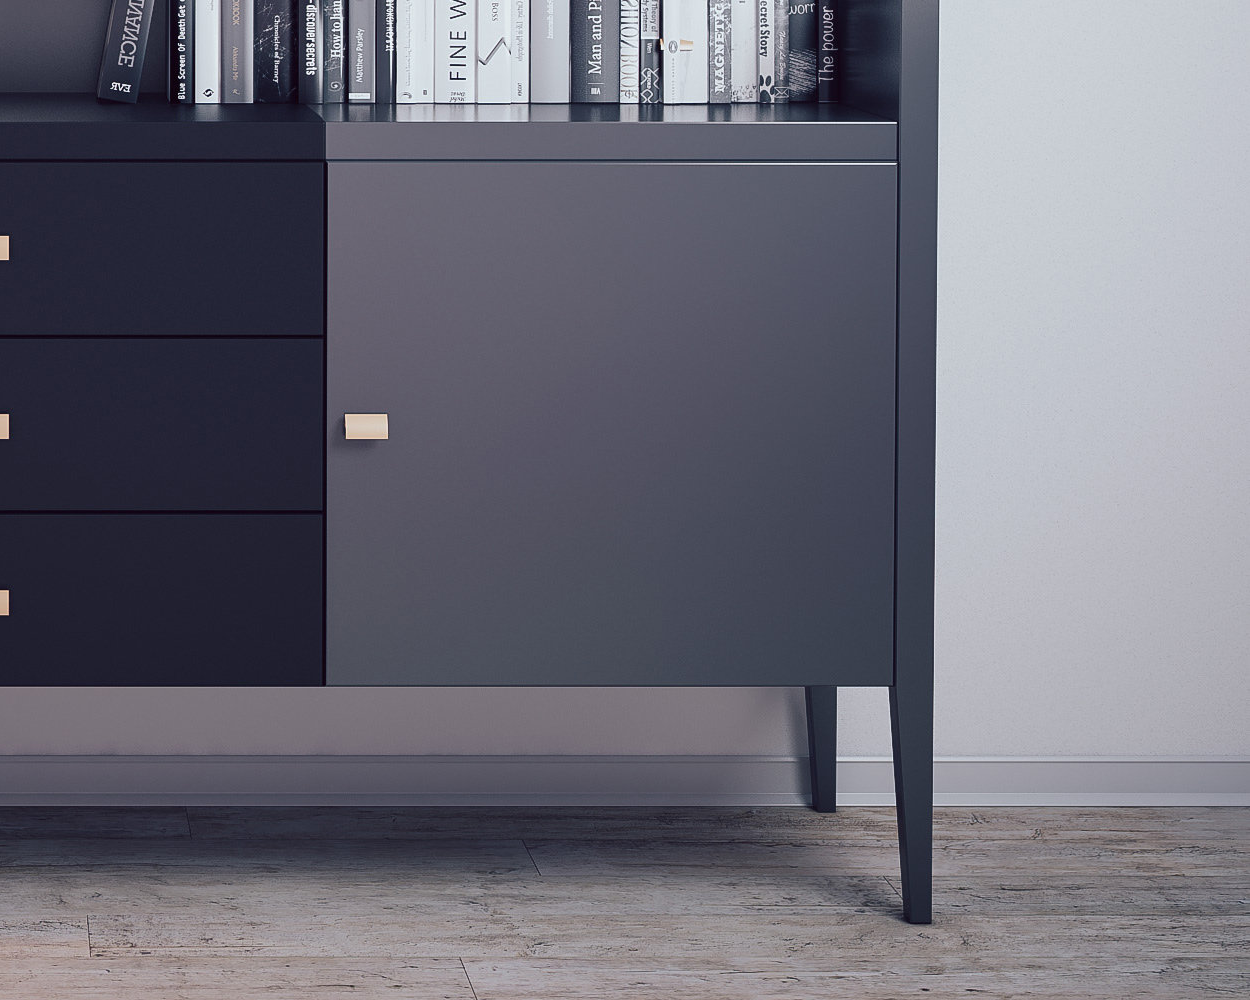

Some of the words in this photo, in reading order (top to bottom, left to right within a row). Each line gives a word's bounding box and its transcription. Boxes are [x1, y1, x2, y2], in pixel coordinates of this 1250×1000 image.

[178, 4, 187, 18] Get
[306, 5, 319, 42] discover
[641, 7, 649, 33] Systems
[650, 3, 659, 24] Theory
[178, 19, 187, 40] Death
[272, 15, 281, 50] Chronicles
[330, 22, 342, 33] to
[355, 28, 366, 51] Parsley
[587, 13, 603, 41] and
[822, 5, 838, 51] power
[178, 42, 187, 52] Of
[330, 34, 342, 58] How
[449, 31, 467, 81] FINE
[714, 2, 725, 94] MAGNETIC
[759, 29, 770, 58] Story
[178, 55, 187, 80] Screen
[272, 60, 281, 84] Barney
[306, 43, 319, 76] secrets
[355, 52, 365, 83] Matthew
[588, 42, 603, 75] Man
[818, 55, 834, 84] The
[178, 82, 187, 100] Blue
